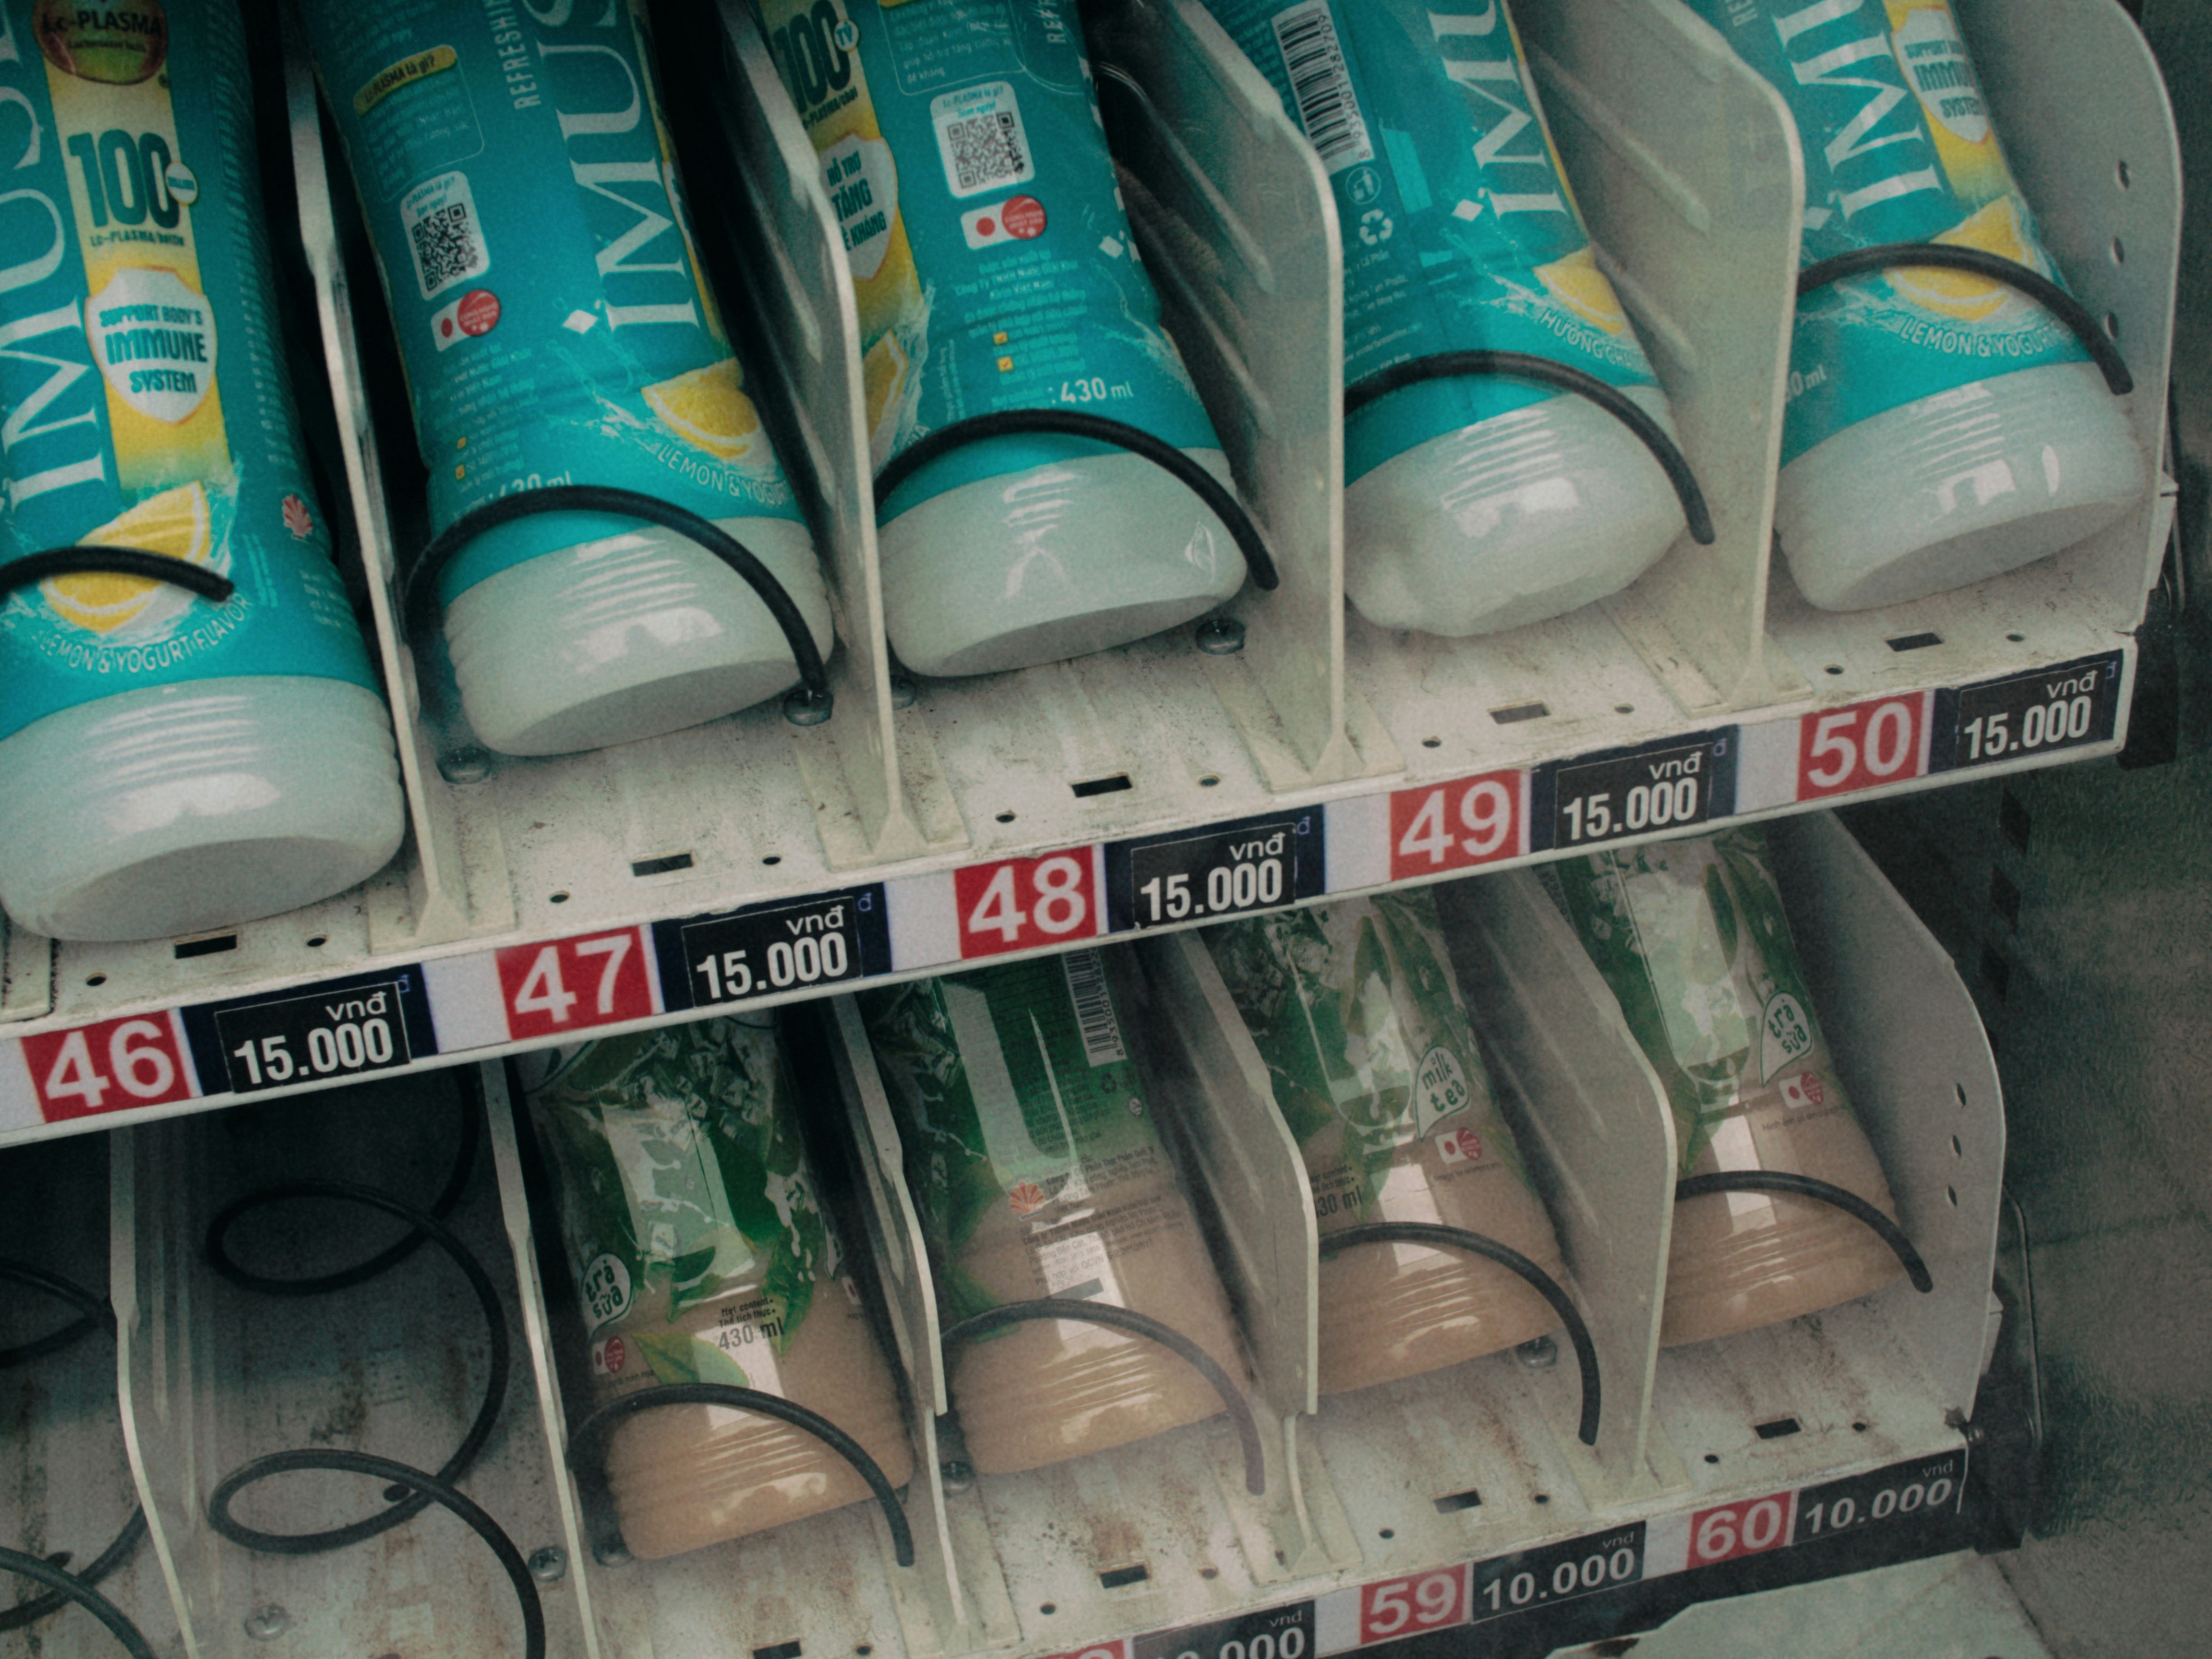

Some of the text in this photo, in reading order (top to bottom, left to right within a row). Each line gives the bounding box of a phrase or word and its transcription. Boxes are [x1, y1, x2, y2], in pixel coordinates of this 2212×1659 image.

[773, 0, 851, 113] 100
[67, 129, 180, 229] 100
[99, 303, 159, 327] SUPPORT
[105, 328, 207, 365] IMMUNE
[1900, 316, 1972, 357] LEMON
[1978, 336, 1991, 357] &
[129, 369, 197, 393] SYSTEM
[1060, 377, 1106, 404] 430
[1111, 381, 1134, 398] ml
[1805, 365, 1827, 390] ml
[657, 442, 740, 497] LEMON &
[98, 648, 110, 673] &
[117, 636, 192, 673] YOGURT
[193, 593, 252, 650] FLAVOR
[2046, 670, 2098, 699] vnđ
[1807, 702, 1912, 787] 50
[1964, 695, 2092, 759] 15.000
[1648, 751, 1704, 781] vnđ
[1398, 780, 1512, 864] 49
[1562, 776, 1699, 841] 15.000
[1228, 831, 1285, 861] vnđ
[968, 856, 1087, 943] 48
[1140, 858, 1282, 921] 15.000
[785, 905, 844, 936] vnđ
[513, 934, 634, 1023] 47
[696, 932, 849, 999] 15.000
[325, 992, 387, 1022] vnđ
[1768, 998, 1795, 1039] trà
[233, 1019, 394, 1084] 15.000
[1781, 1022, 1809, 1055] sữa
[44, 1020, 175, 1108] 46
[1421, 1051, 1454, 1091] milk
[1430, 1078, 1467, 1114] tea
[1341, 1186, 1363, 1208] ml
[585, 1259, 615, 1303] trà
[716, 1317, 784, 1350] 430 ml
[1921, 1459, 1954, 1477] vnd
[1804, 1478, 1953, 1535] 10.000
[1601, 1532, 1634, 1550] vnd
[1695, 1500, 1783, 1560] 60
[1482, 1548, 1635, 1611] 10.000
[1269, 1609, 1303, 1628] vnd
[1368, 1572, 1457, 1632] 59
